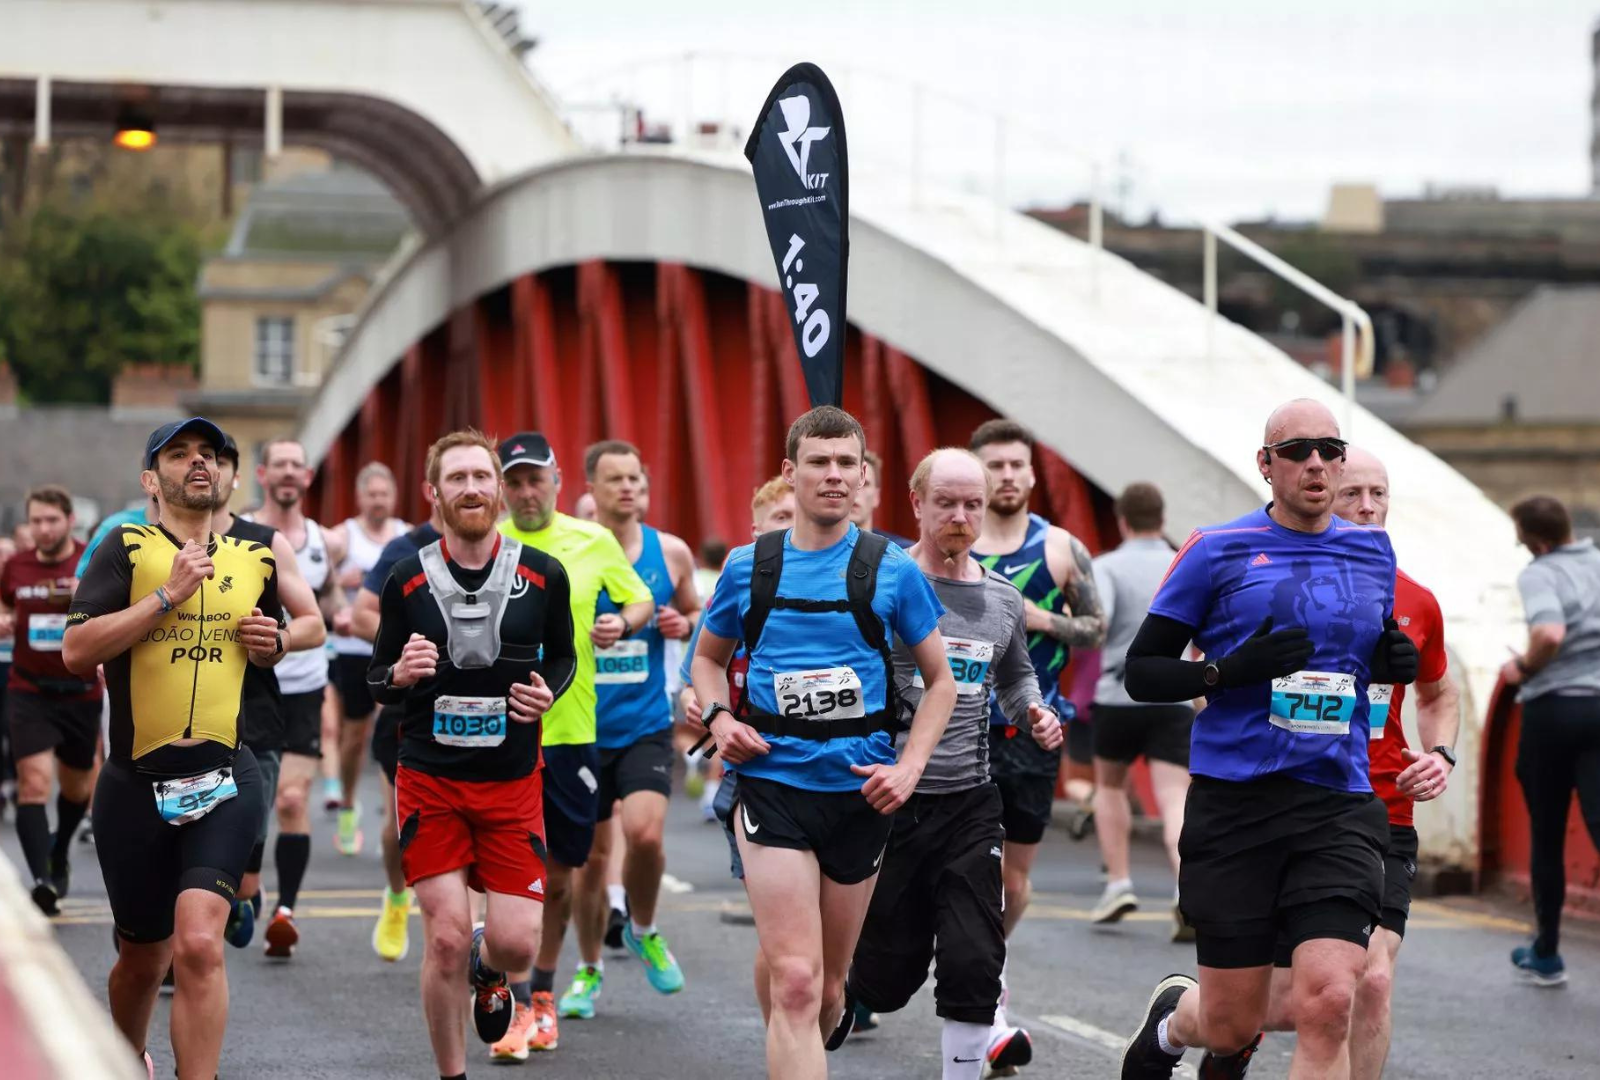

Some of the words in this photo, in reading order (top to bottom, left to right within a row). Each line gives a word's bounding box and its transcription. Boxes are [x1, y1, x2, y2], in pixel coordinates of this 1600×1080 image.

[807, 172, 830, 190] KIT
[781, 233, 831, 358] 1:40
[177, 612, 231, 622] WIKABOO
[170, 646, 223, 664] POR
[950, 658, 984, 683] 30
[782, 688, 858, 720] 2138
[1284, 693, 1343, 721] 742
[437, 714, 502, 736] 1030
